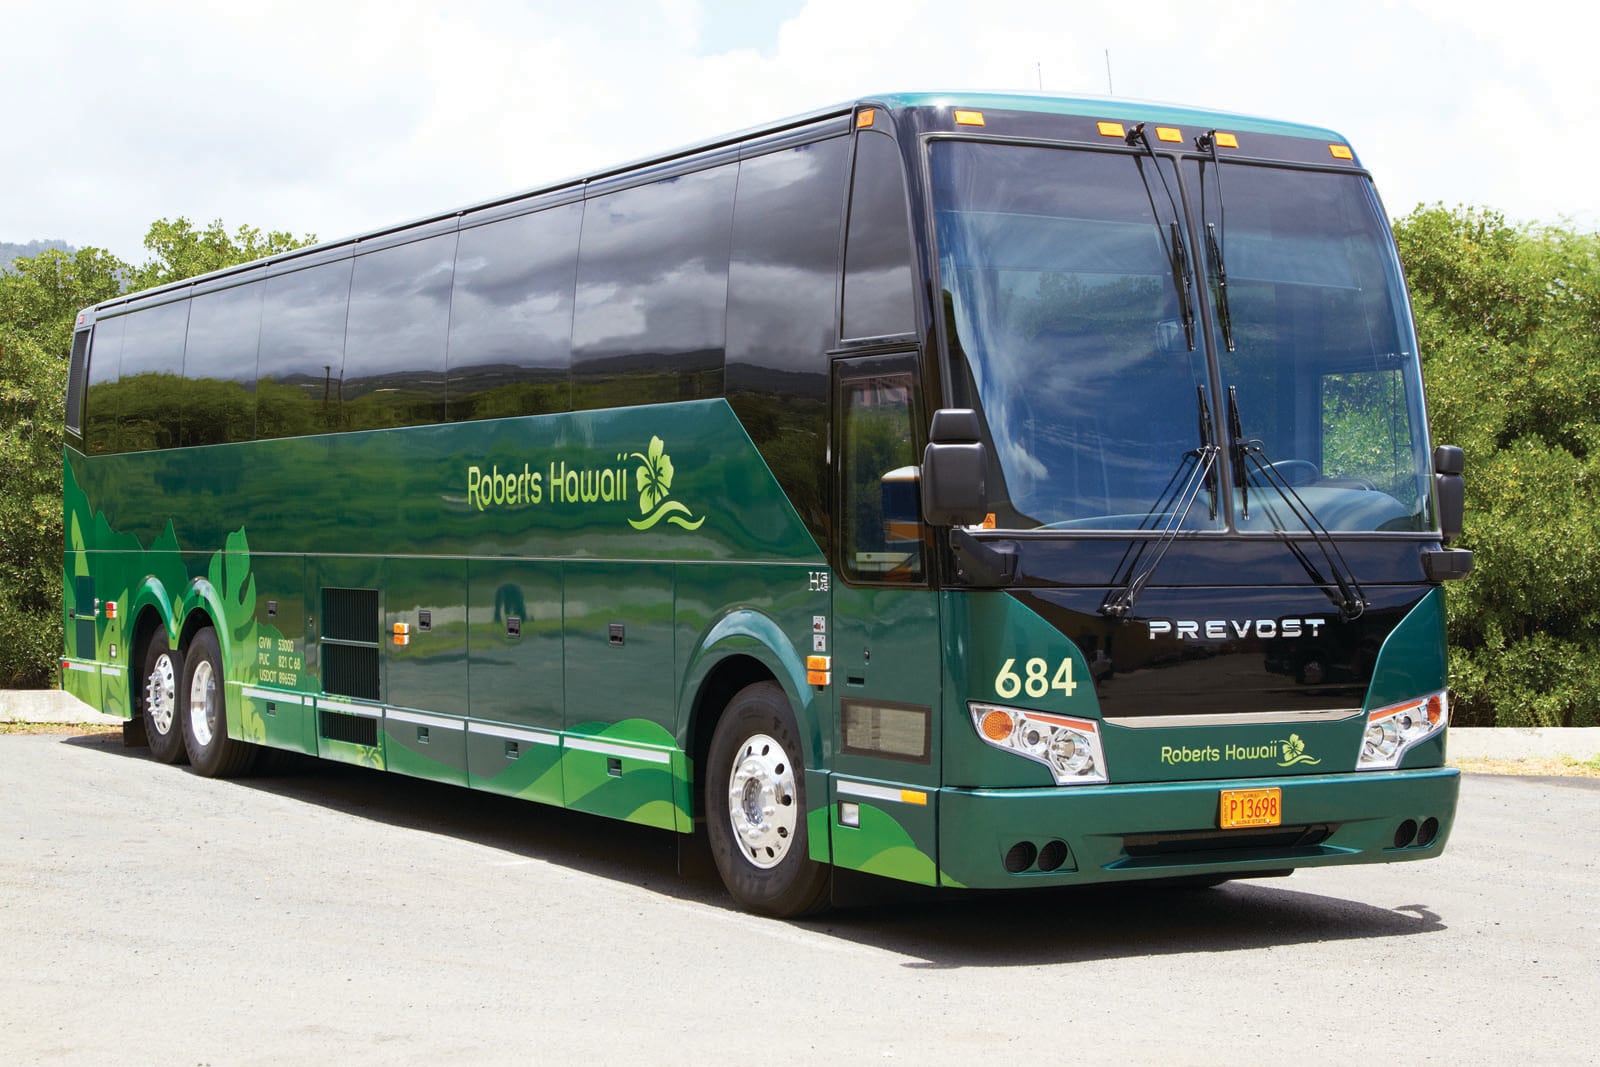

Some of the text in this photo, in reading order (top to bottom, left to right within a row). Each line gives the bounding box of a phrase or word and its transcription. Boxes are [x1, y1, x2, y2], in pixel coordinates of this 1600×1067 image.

[468, 452, 627, 511] Roberts Hawaii
[1149, 618, 1326, 640] PREVOST
[258, 636, 272, 649] GVW
[259, 669, 277, 683] USDOT
[994, 657, 1077, 699] 684
[1161, 740, 1278, 765] Roberts Hawaii
[1230, 797, 1277, 820] P13698
